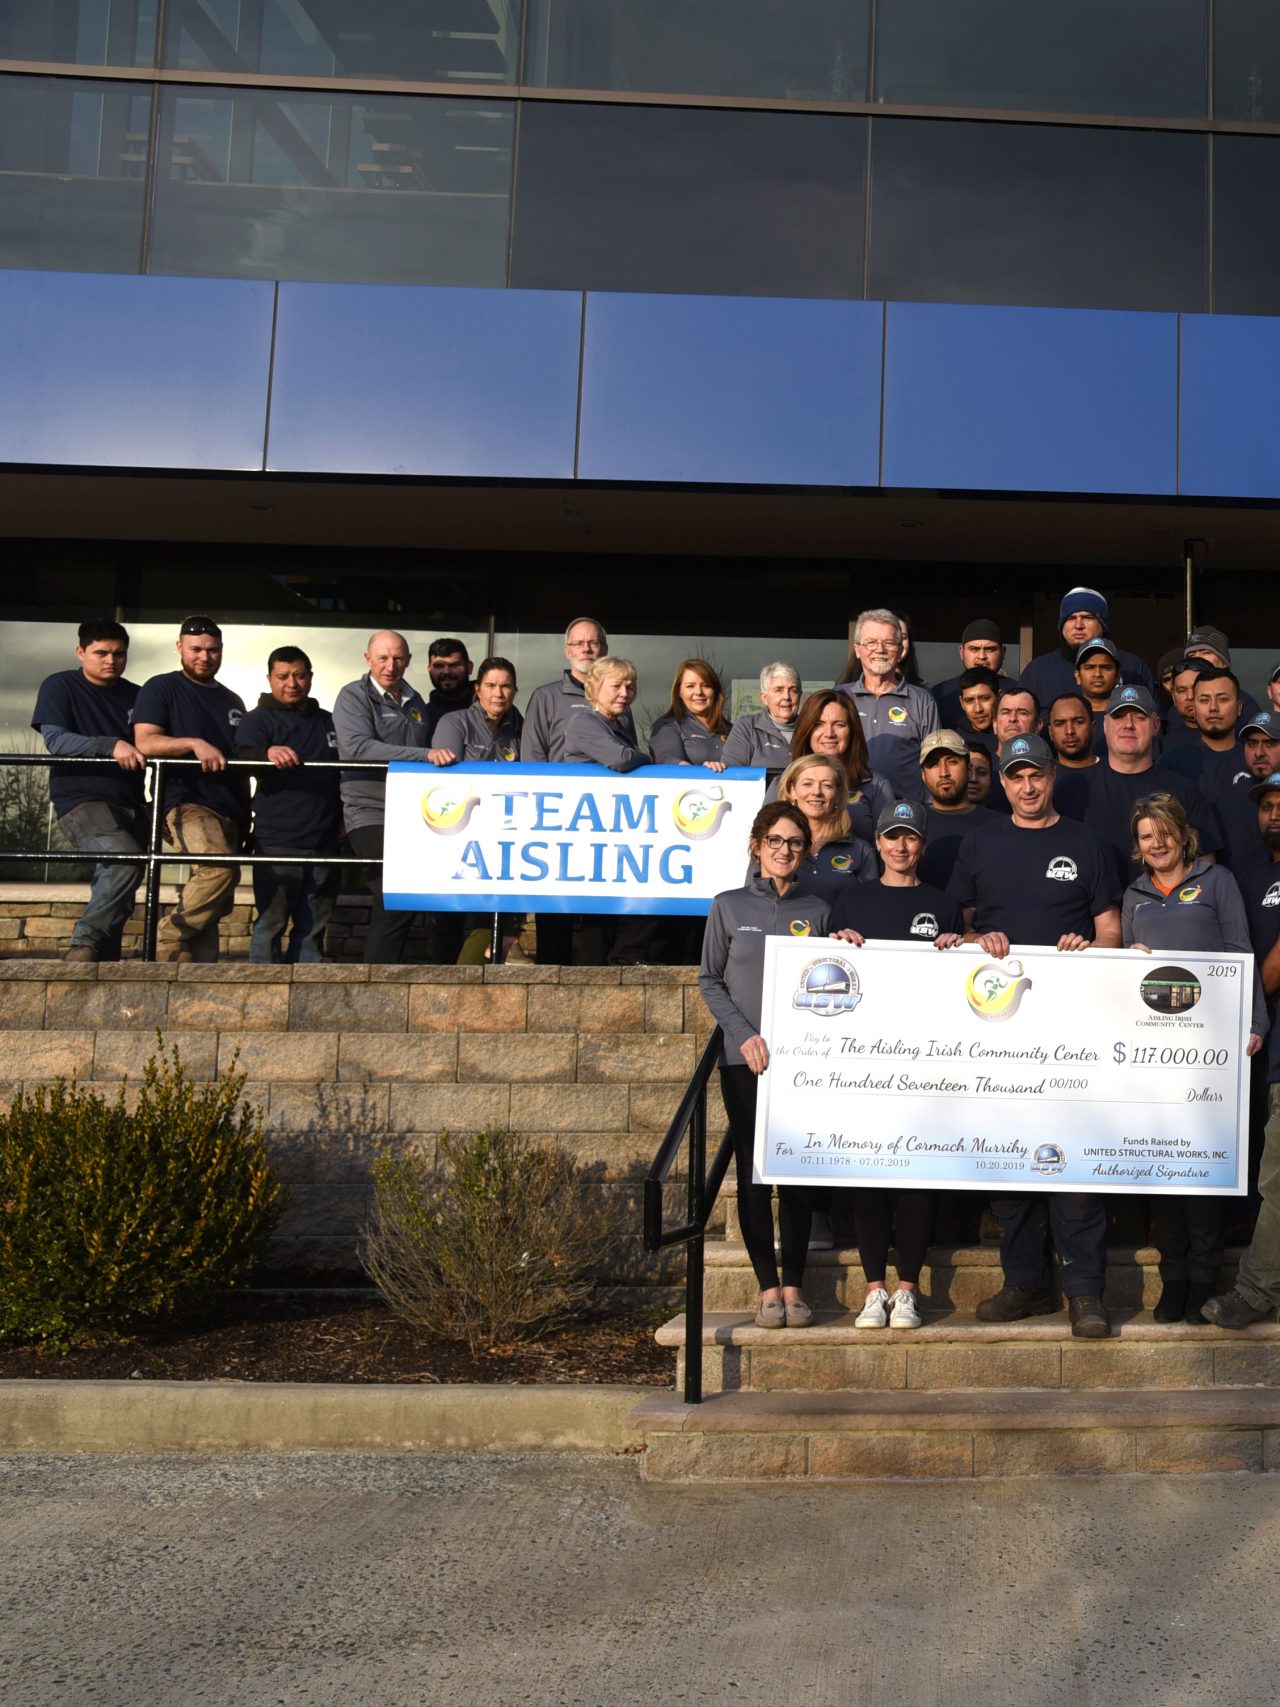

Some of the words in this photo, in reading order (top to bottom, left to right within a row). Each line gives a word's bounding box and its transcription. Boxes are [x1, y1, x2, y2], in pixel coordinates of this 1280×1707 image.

[492, 791, 659, 834] TEAM
[451, 840, 693, 885] AISLING
[813, 957, 847, 968] STRUCTURAL
[1207, 965, 1238, 978] 2019
[1135, 1020, 1176, 1028] COMMUNITY
[1178, 1021, 1205, 1029] CENTER
[1147, 1014, 1174, 1022] AISLING
[1174, 1015, 1193, 1023] IRISH
[804, 1032, 820, 1045] Pay
[822, 1033, 831, 1043] to
[776, 1045, 790, 1056] the
[792, 1046, 818, 1057] Order
[821, 1047, 832, 1060] of
[841, 1037, 866, 1055] The
[870, 1038, 922, 1061] Aisling
[925, 1039, 963, 1058] Irish
[969, 1041, 1049, 1065] Community
[1053, 1044, 1101, 1062] Center
[1113, 1041, 1127, 1066] $
[1130, 1047, 1229, 1067] 117.000.00
[793, 1070, 823, 1088] One
[829, 1071, 895, 1090] Hundred
[897, 1073, 970, 1092] Seventeen
[975, 1076, 1046, 1094] Thousand
[1049, 1077, 1089, 1090] 00/100
[1186, 1086, 1224, 1103] Dollars
[775, 1142, 795, 1156] For
[804, 1132, 823, 1149] In
[828, 1133, 883, 1155] Memory
[887, 1135, 904, 1155] of
[906, 1135, 966, 1153] Cormach
[970, 1137, 1030, 1158] Murrihy
[1123, 1137, 1149, 1146] Funds
[1150, 1138, 1179, 1147] Raised
[1180, 1138, 1192, 1148] by
[1084, 1148, 1117, 1157] UNITED
[1118, 1149, 1175, 1158] STRUCTURAL
[1176, 1150, 1211, 1160] WORKS,
[1212, 1150, 1230, 1159] INC.
[800, 1156, 851, 1165] 07.11.1978
[859, 1157, 910, 1168] 07.07.2019
[975, 1160, 1025, 1170] 10.20.2019
[1092, 1163, 1154, 1182] Authorized
[1155, 1164, 1210, 1181] Signature
